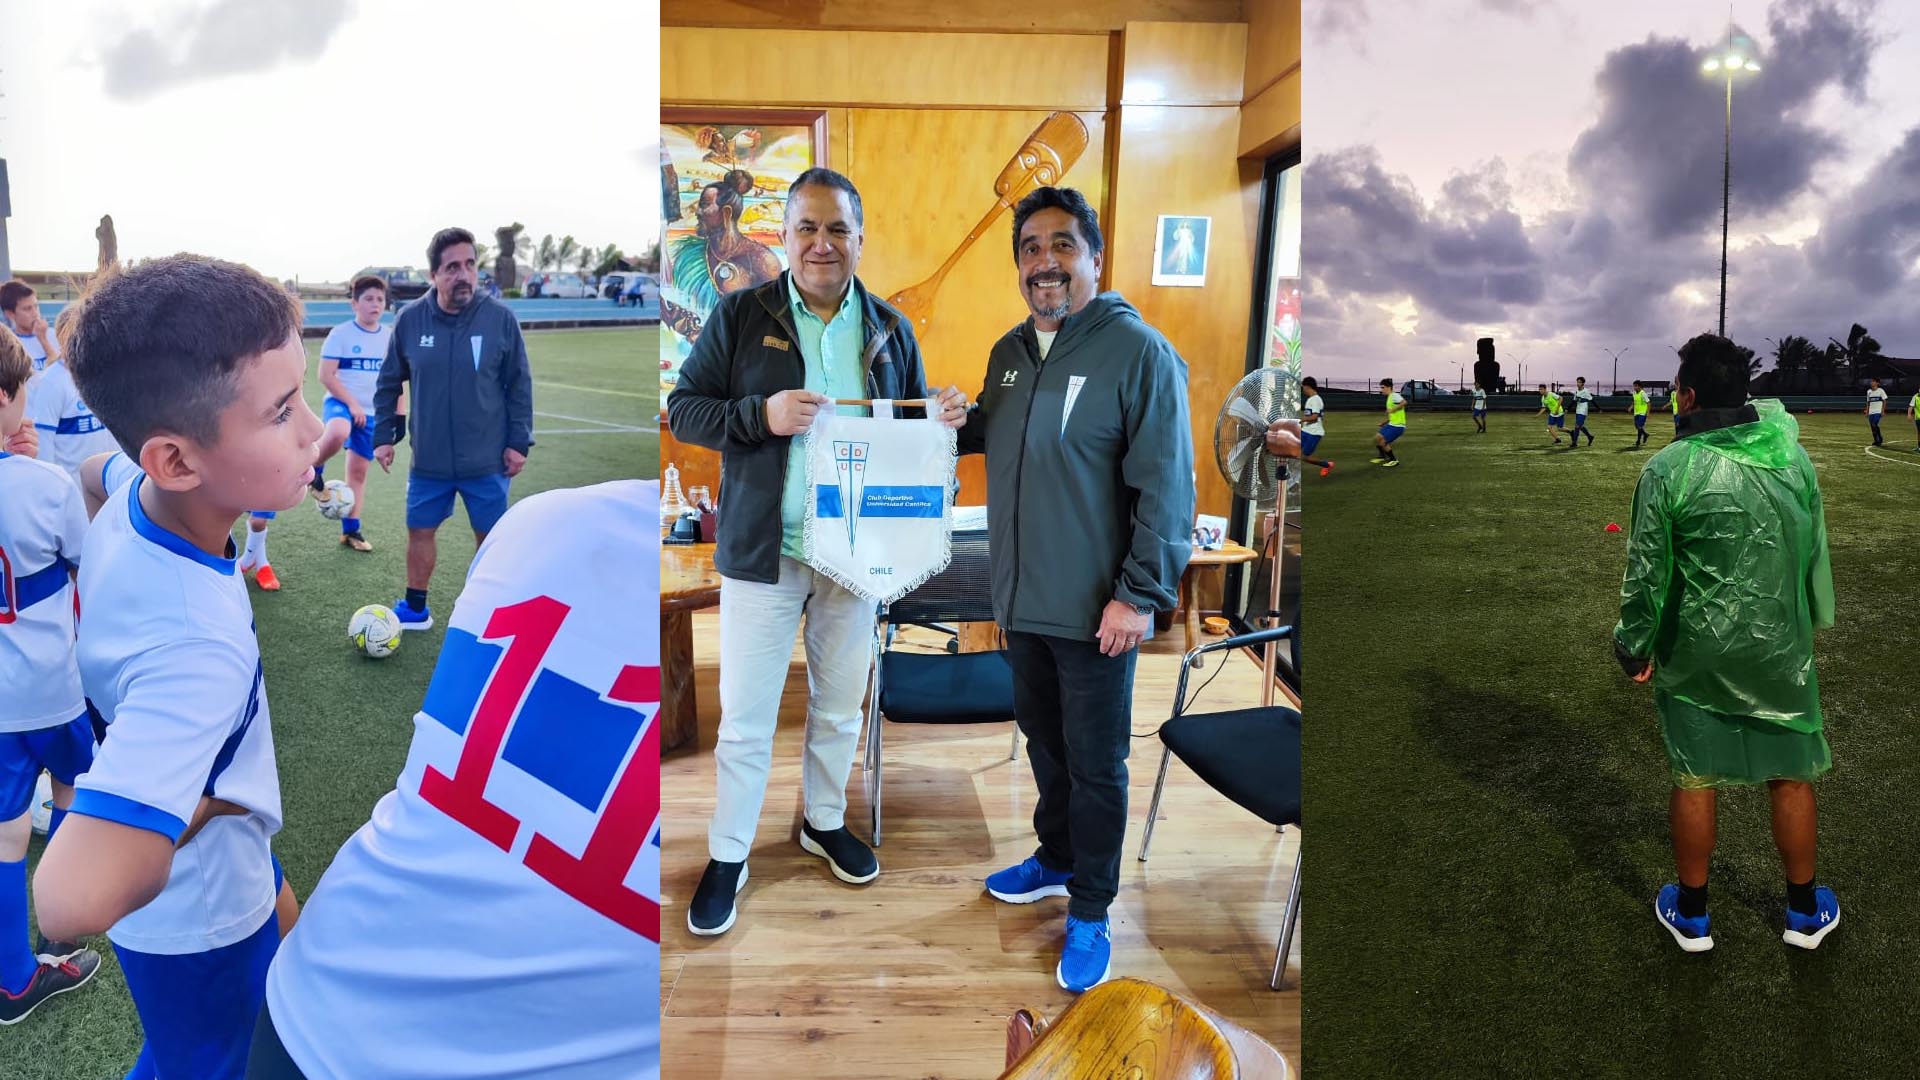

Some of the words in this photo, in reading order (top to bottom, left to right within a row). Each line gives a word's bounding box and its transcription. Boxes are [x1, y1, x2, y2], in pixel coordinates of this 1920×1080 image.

[841, 448, 848, 456] C
[854, 448, 862, 457] D
[841, 462, 848, 471] U
[854, 463, 862, 472] C
[869, 567, 893, 575] CHILE
[418, 594, 660, 945] 11
